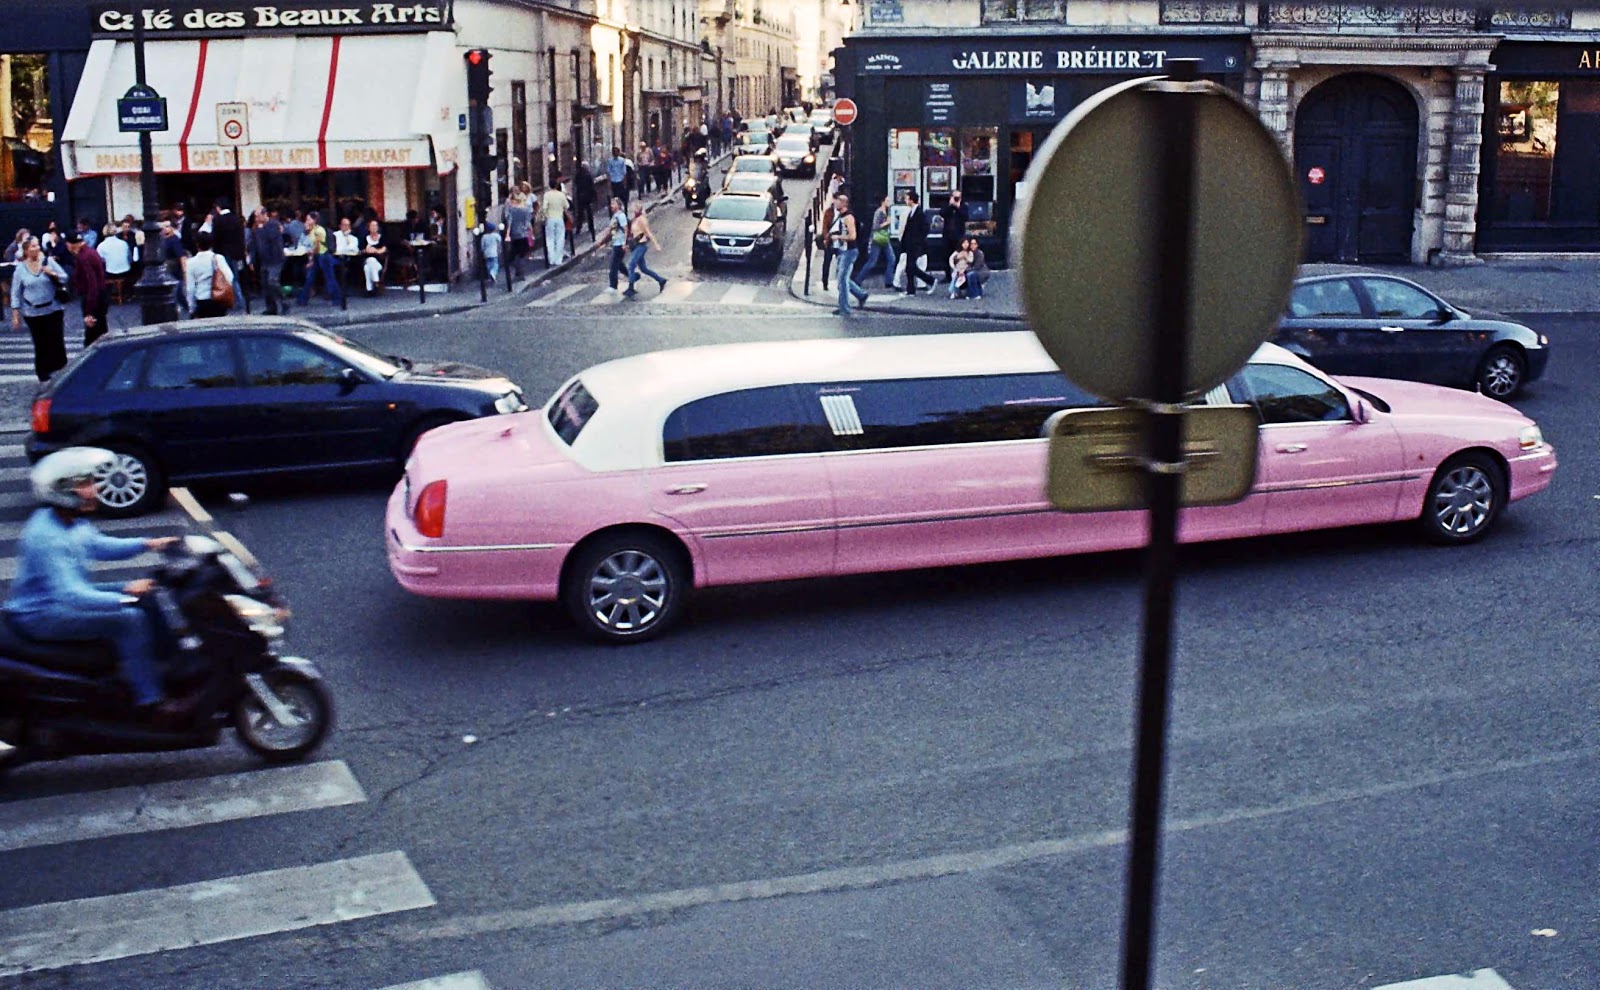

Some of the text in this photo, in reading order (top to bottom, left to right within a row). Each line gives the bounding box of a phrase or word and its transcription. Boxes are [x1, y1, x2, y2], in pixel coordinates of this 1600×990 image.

[183, 9, 246, 29] des
[253, 6, 363, 27] Beaux
[371, 3, 441, 23] Arts
[867, 54, 900, 63] MAISON
[952, 51, 1043, 70] GALERIE
[344, 148, 412, 164] BREAKFAST
